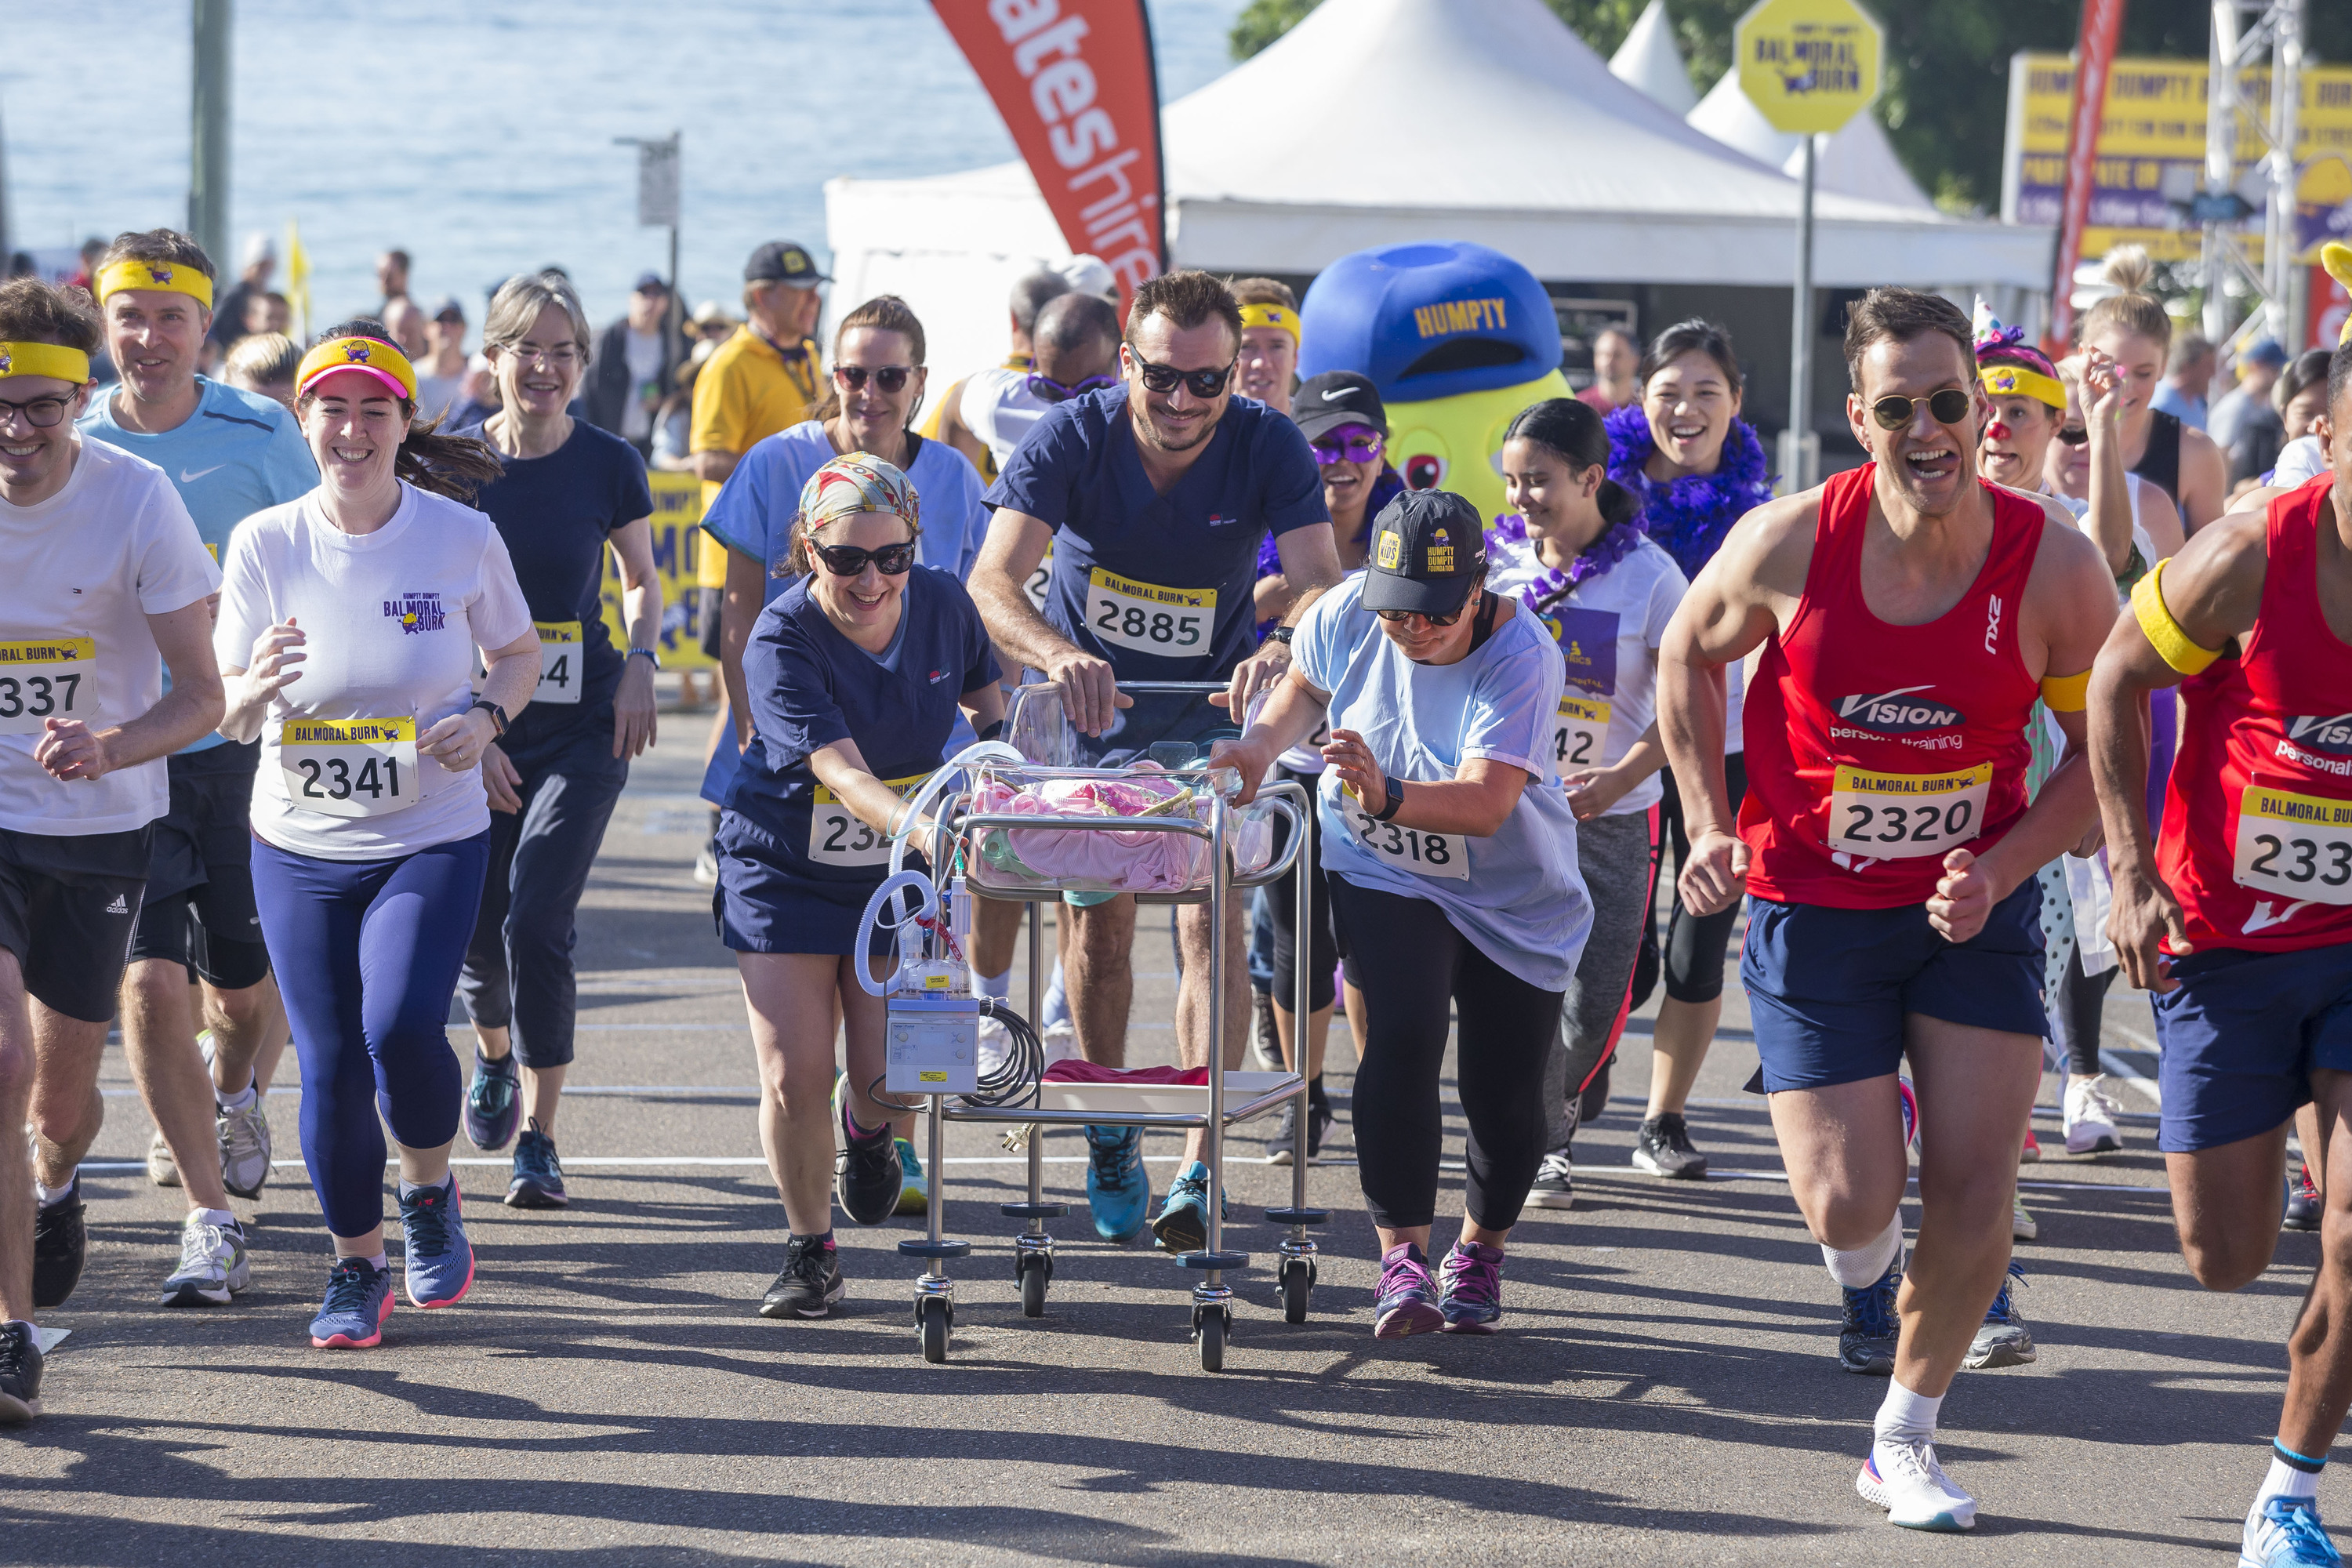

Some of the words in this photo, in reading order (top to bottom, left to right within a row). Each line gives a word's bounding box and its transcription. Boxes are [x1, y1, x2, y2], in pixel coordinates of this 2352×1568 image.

[1414, 299, 1506, 338] HUMPTY
[1428, 546, 1454, 556] HUMPTY
[1428, 556, 1454, 565] DUMPTY
[1105, 576, 1155, 599] BALMORAL
[1157, 590, 1184, 604] BURN
[383, 601, 446, 617] BALMORAL
[417, 615, 445, 631] BURN
[1097, 600, 1200, 646] 2885
[1985, 593, 2002, 655] 2XU
[26, 647, 56, 659] BURN
[1838, 685, 1957, 725] VISION
[296, 727, 348, 741] BALMORAL
[351, 725, 379, 740] BURN
[298, 756, 400, 800] 2341
[1853, 776, 1918, 793] BALMORAL
[1922, 778, 1954, 792] BURN
[1843, 800, 1972, 843] 2320
[2260, 797, 2329, 822] BALMORAL
[1356, 813, 1450, 866] 2318
